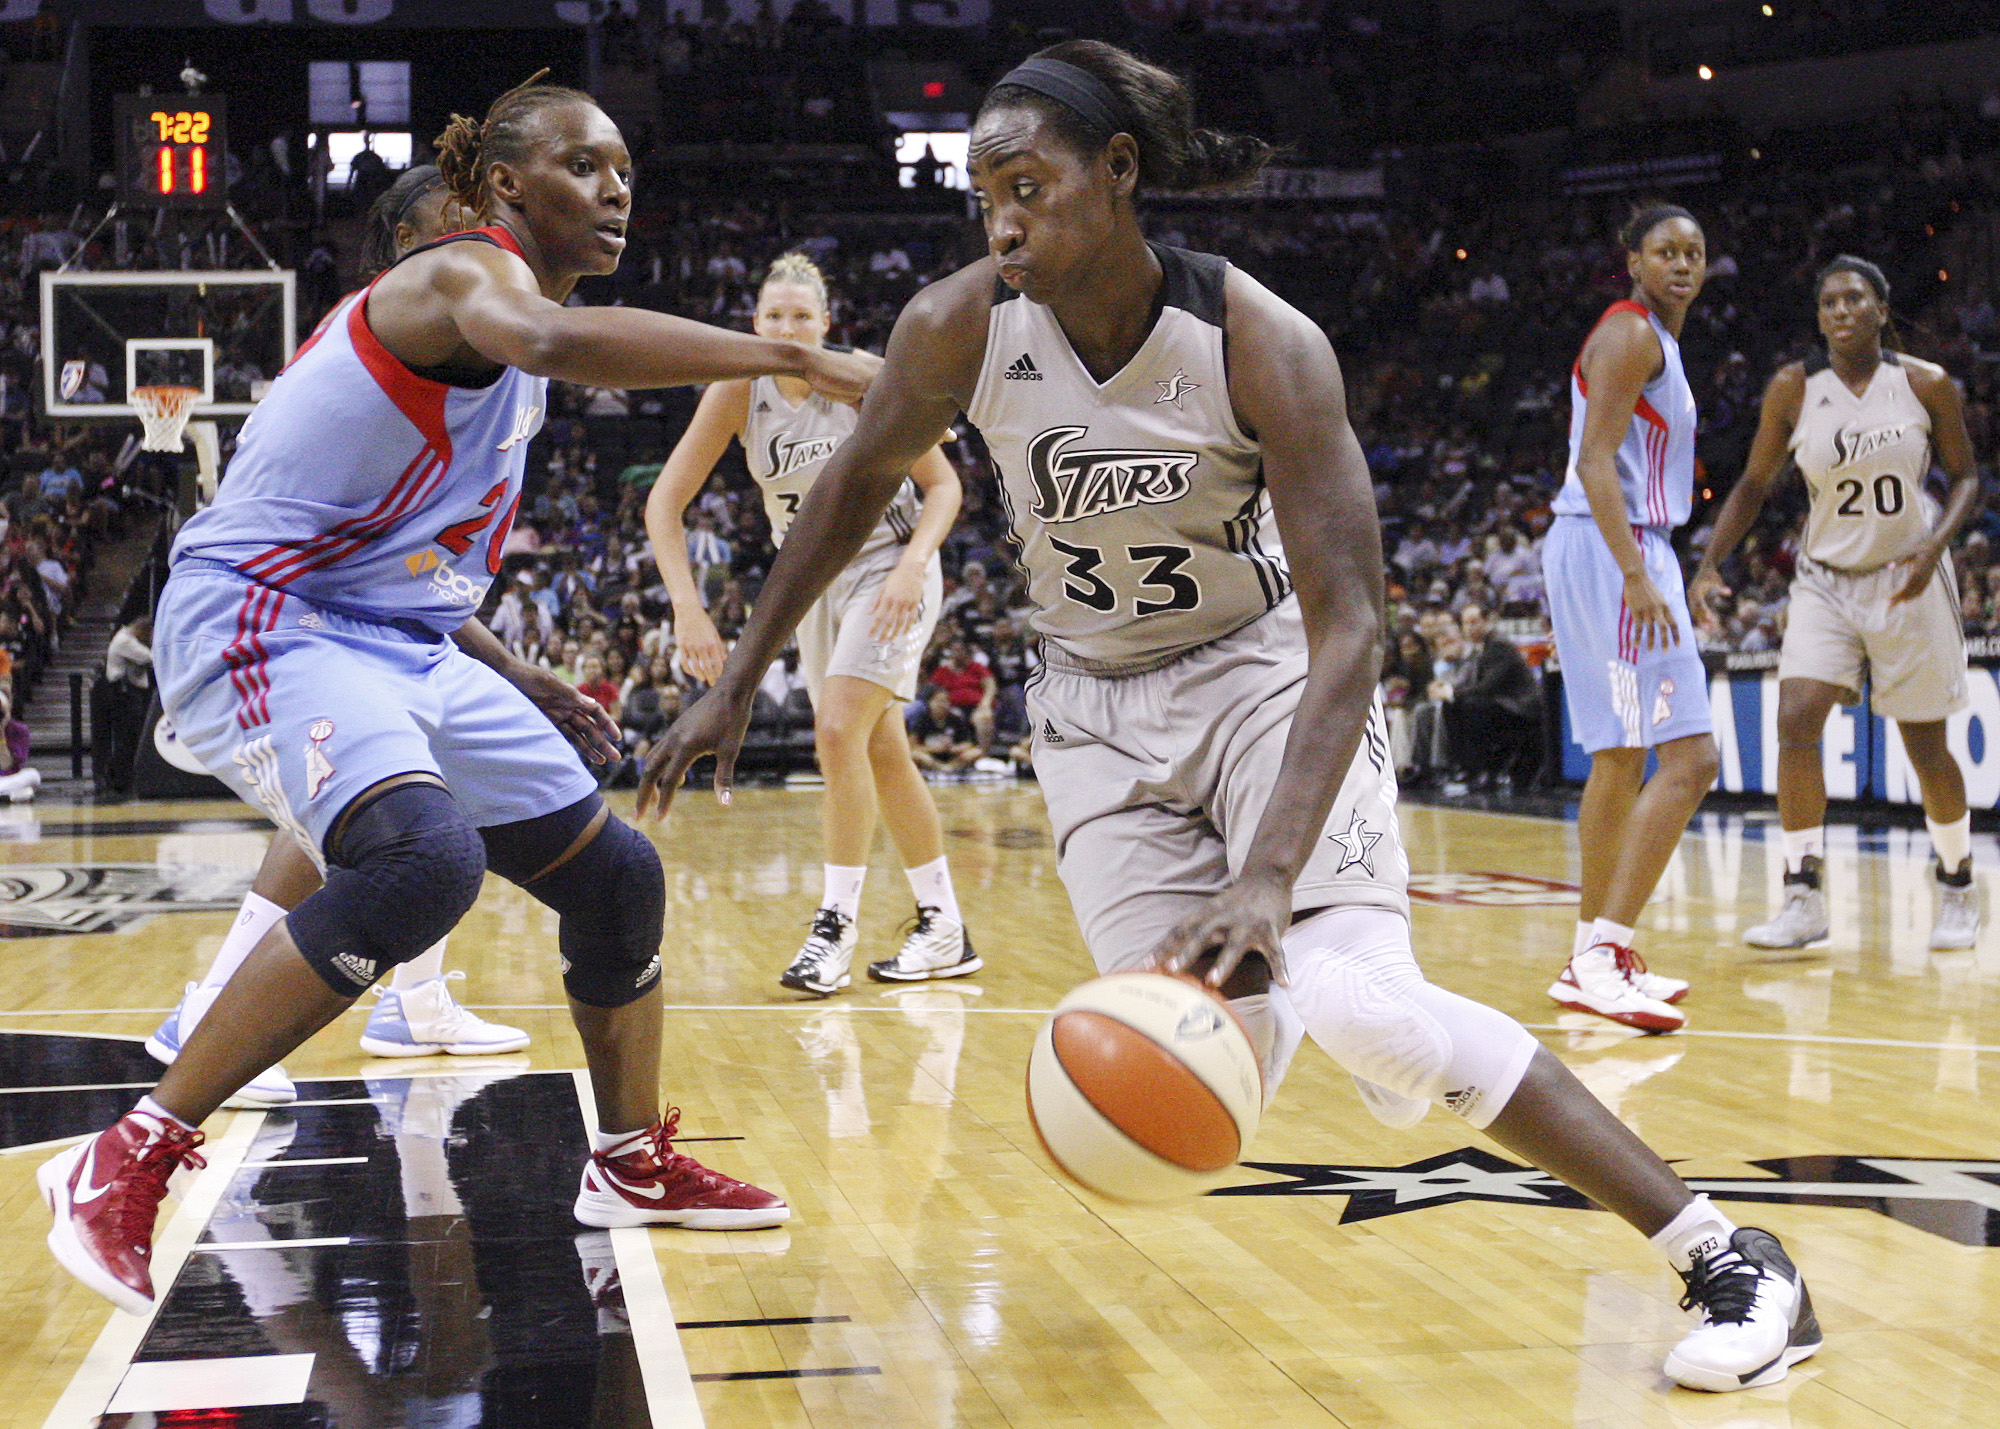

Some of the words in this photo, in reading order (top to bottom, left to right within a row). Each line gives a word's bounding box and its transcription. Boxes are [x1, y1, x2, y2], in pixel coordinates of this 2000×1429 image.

[150, 111, 210, 144] 7:22
[158, 146, 209, 195] 11
[1004, 370, 1043, 381] adidas
[1836, 474, 1903, 517] 20
[1046, 532, 1202, 617] 33
